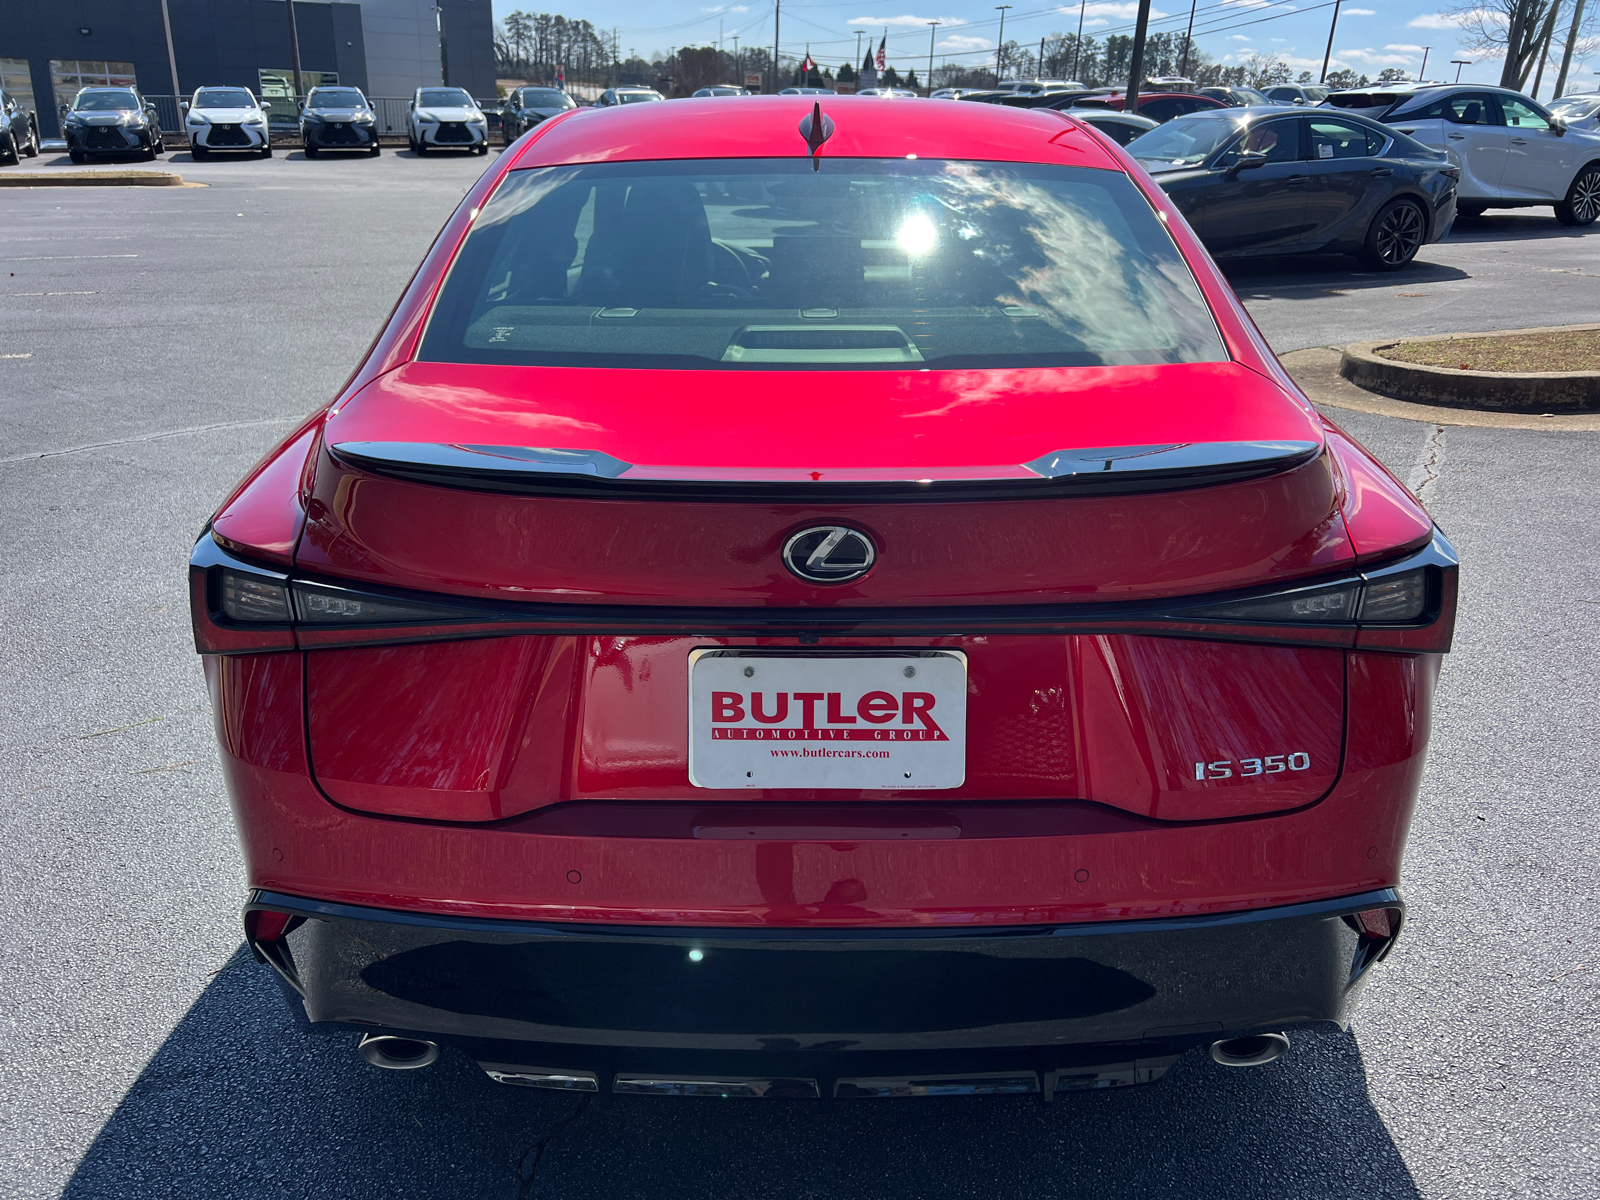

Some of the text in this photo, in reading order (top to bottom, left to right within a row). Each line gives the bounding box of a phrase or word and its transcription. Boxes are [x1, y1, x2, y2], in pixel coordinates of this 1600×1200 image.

[713, 729, 941, 740] AUTOMOTIVE GROUP
[770, 748, 890, 759] www.butlercars.com
[1195, 752, 1310, 780] IS 350
